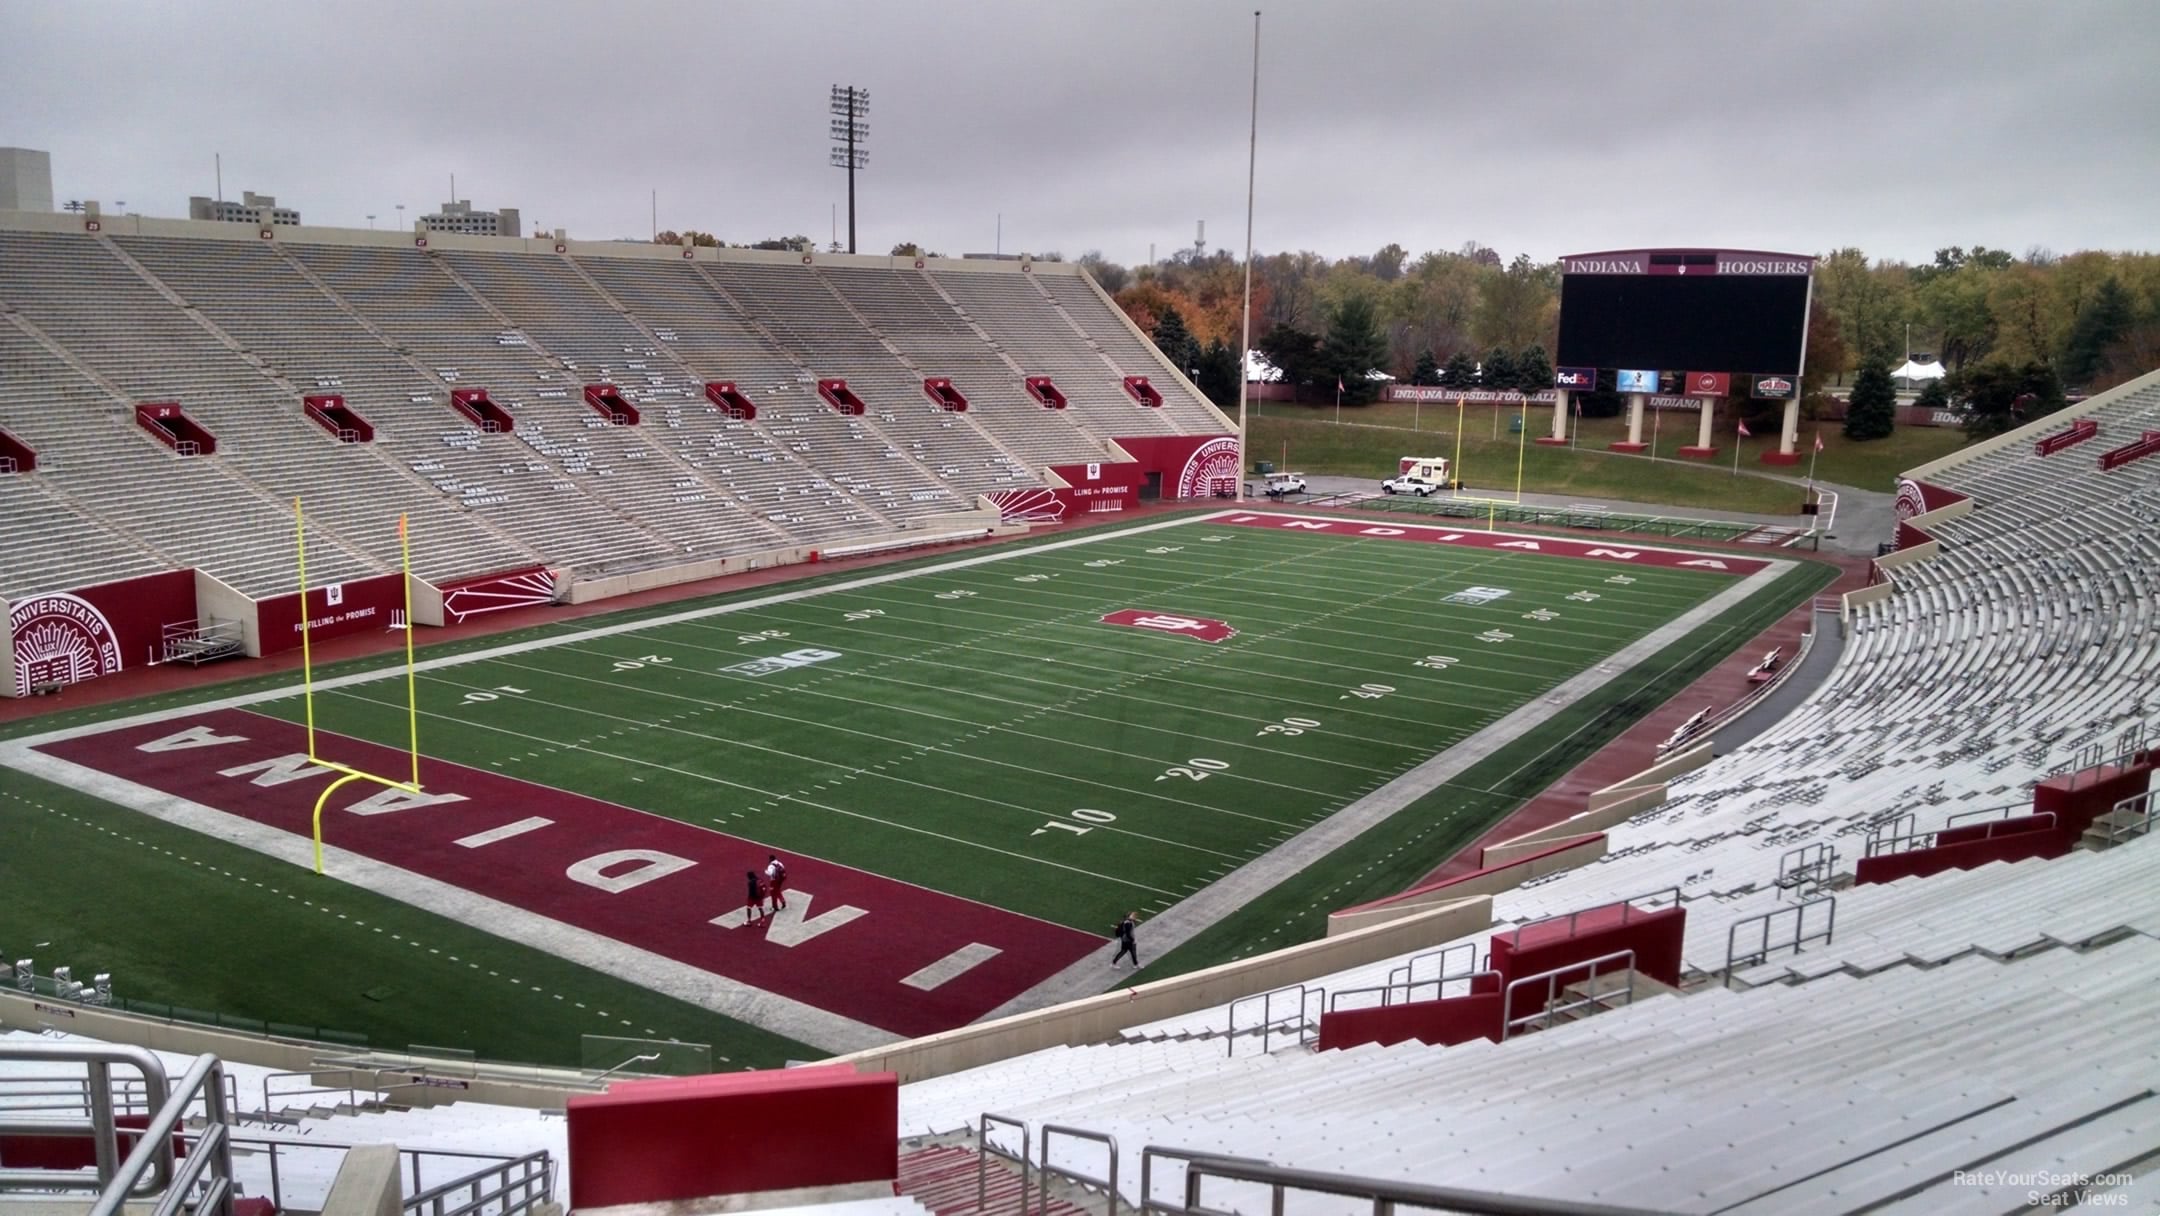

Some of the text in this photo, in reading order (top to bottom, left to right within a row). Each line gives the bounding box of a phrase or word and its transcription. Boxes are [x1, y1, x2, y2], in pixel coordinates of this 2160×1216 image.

[1571, 260, 1808, 274] INDIANA HOOSIERS
[1557, 373, 1589, 384] FedEx
[1393, 389, 1442, 399] INDIANA
[1496, 391, 1557, 401] FOOALL
[1649, 397, 1701, 409] INDIANA
[159, 408, 170, 417] 24
[1102, 486, 1128, 494] PROMISE
[1230, 516, 1728, 570] INDIANA
[11, 599, 103, 635] UNIVERSITATIS
[294, 616, 334, 632] FUFILLING
[345, 607, 376, 620] PROMISE
[737, 629, 791, 643] 30
[40, 642, 57, 653] LUX
[613, 655, 673, 669] 20
[1413, 655, 1460, 669] 50
[464, 684, 531, 702] 10
[1350, 683, 1396, 699] 40
[1264, 717, 1321, 736] 30
[1165, 758, 1230, 781] 20
[1044, 808, 1117, 836] 10
[135, 725, 1004, 992] INDIANA
